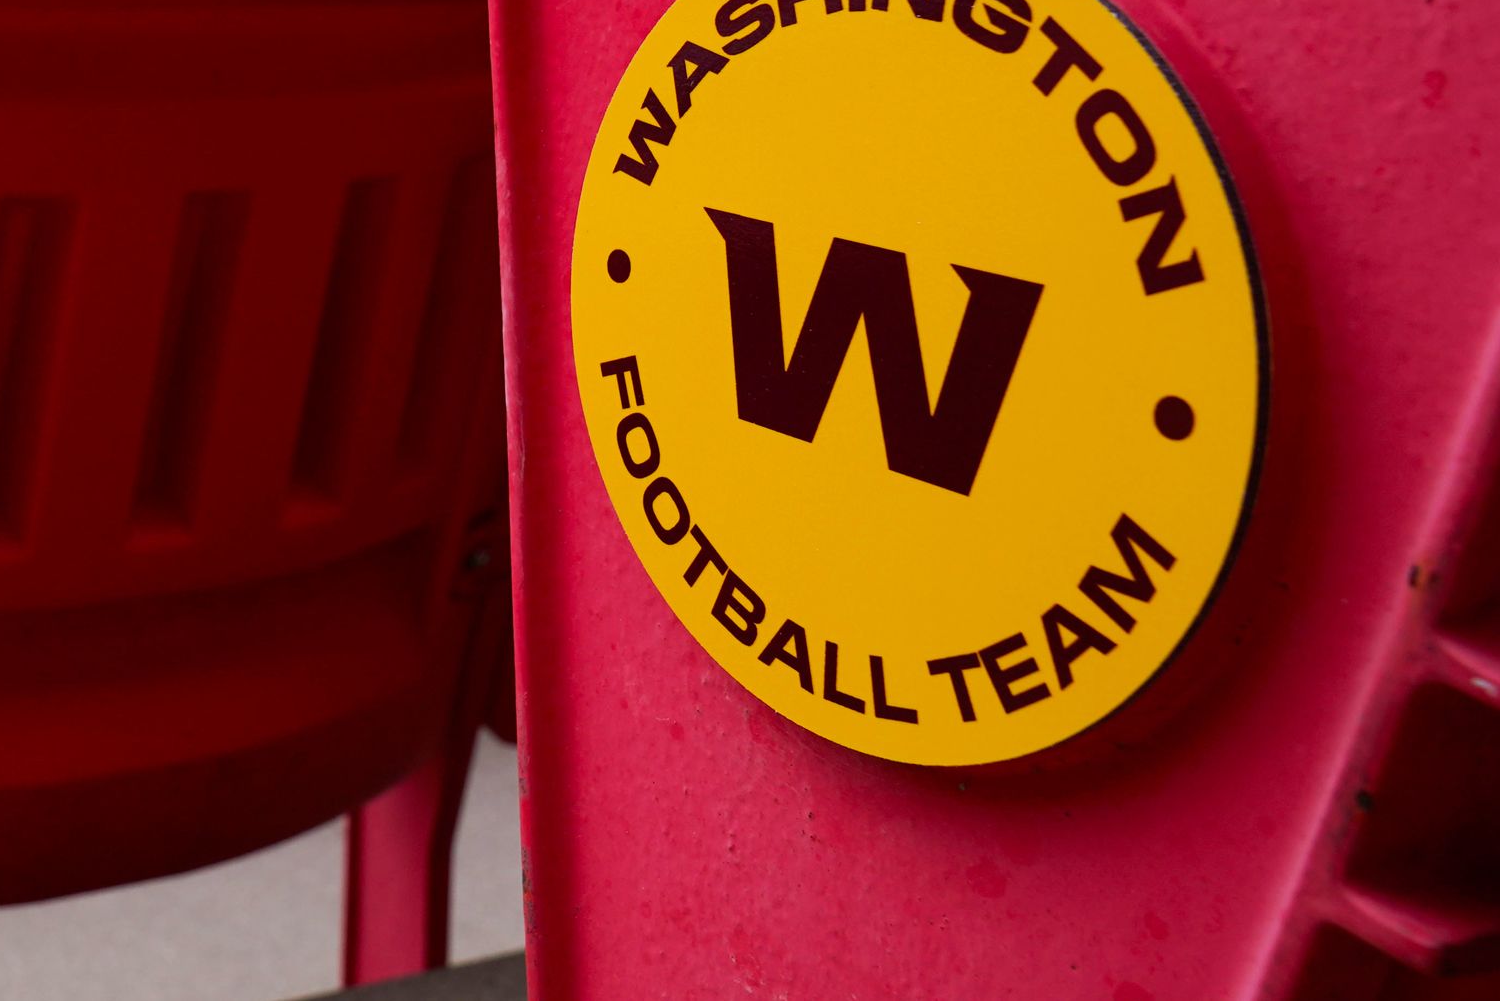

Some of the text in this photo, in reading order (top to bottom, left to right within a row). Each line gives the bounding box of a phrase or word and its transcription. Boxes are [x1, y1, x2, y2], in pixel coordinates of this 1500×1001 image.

[704, 207, 1044, 496] W
[600, 355, 1176, 724] FOOTBALL TEAM
